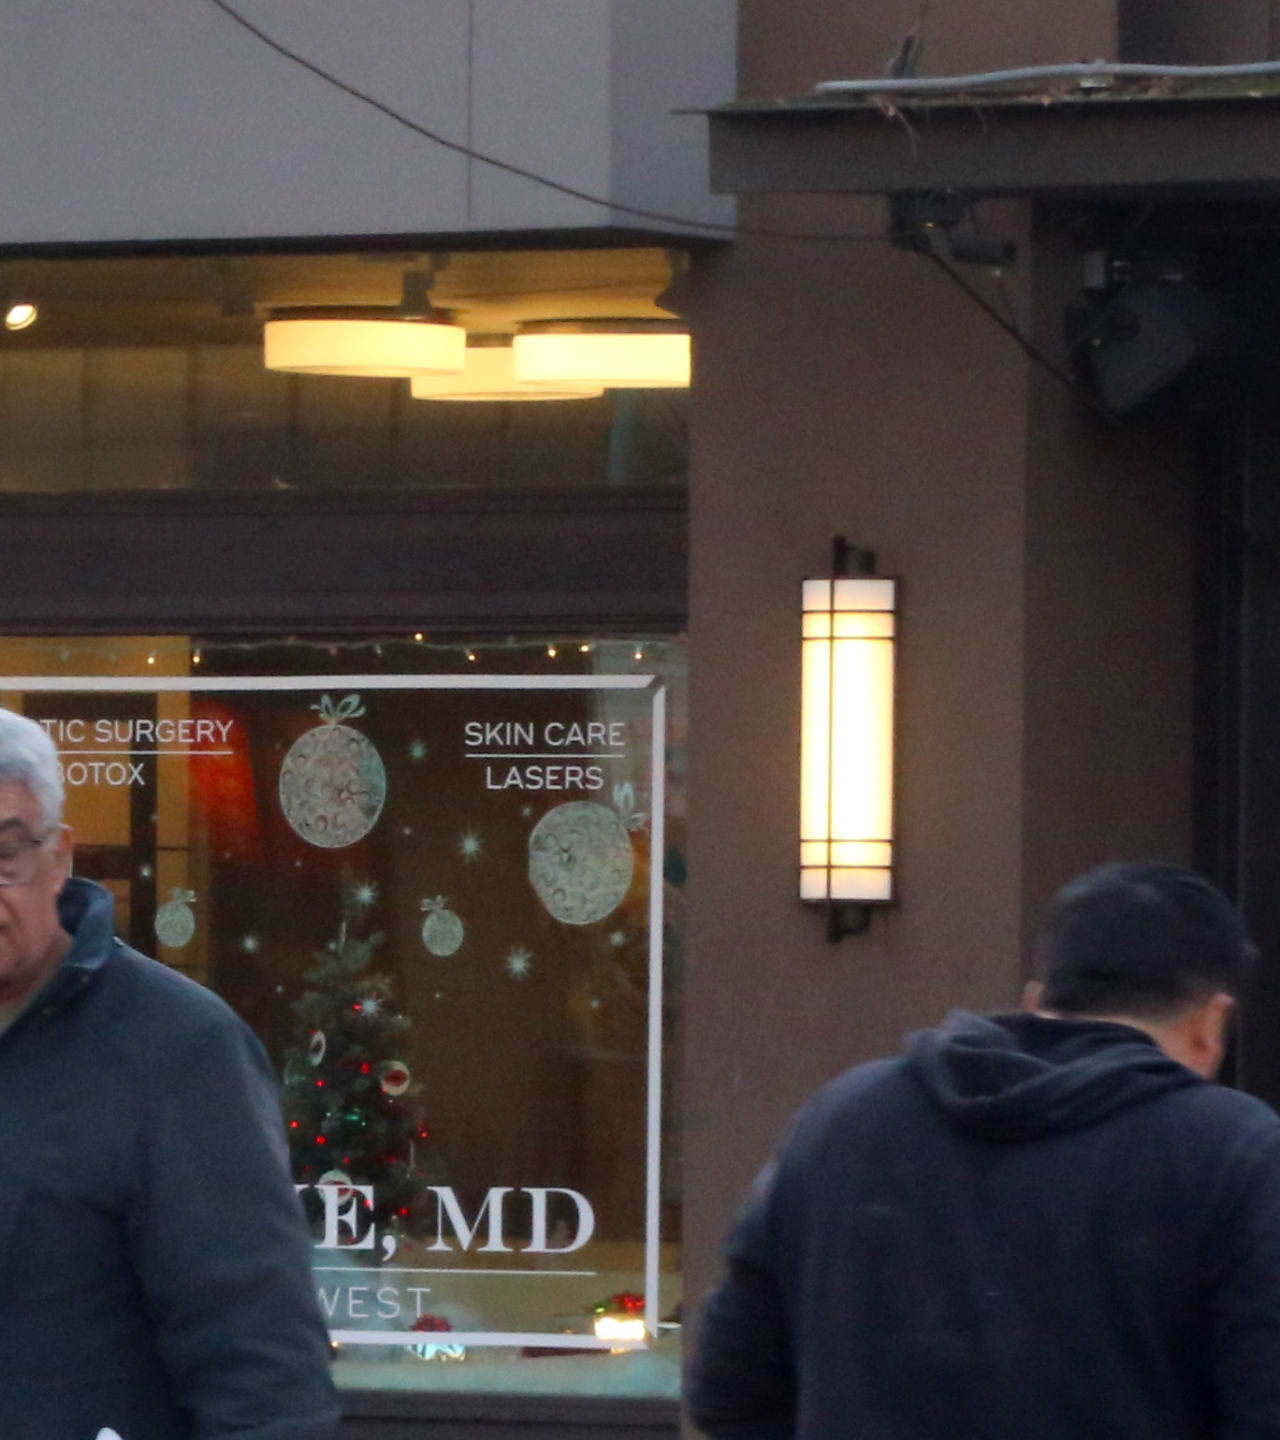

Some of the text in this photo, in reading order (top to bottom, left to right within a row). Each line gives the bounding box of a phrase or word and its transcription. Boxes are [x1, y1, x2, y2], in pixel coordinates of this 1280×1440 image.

[95, 719, 234, 743] SURGERY
[464, 722, 625, 746] SKIN CARE
[486, 766, 604, 789] LASERS
[426, 1185, 595, 1253] MD
